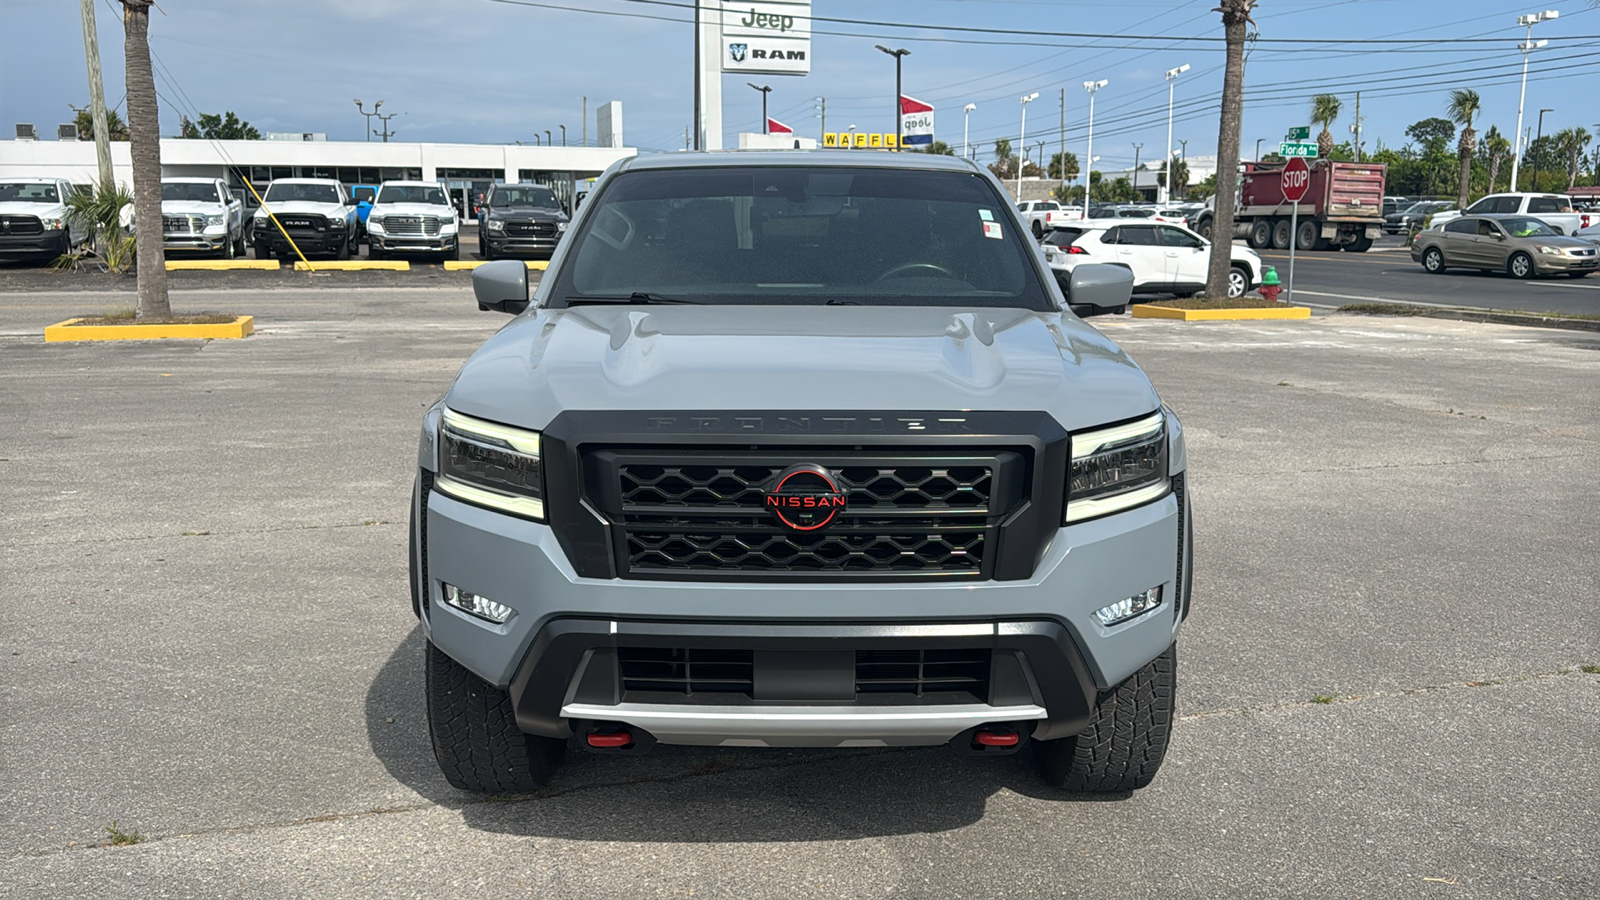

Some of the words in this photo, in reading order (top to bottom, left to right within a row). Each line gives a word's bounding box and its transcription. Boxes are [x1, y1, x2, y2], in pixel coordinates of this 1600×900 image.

[741, 8, 794, 32] Jeep
[752, 49, 805, 60] RAM
[825, 135, 908, 146] WAFFL
[1280, 144, 1307, 155] Florida
[1283, 170, 1307, 188] STOP
[647, 417, 971, 430] FRONTIER
[767, 495, 845, 507] NISSAN
